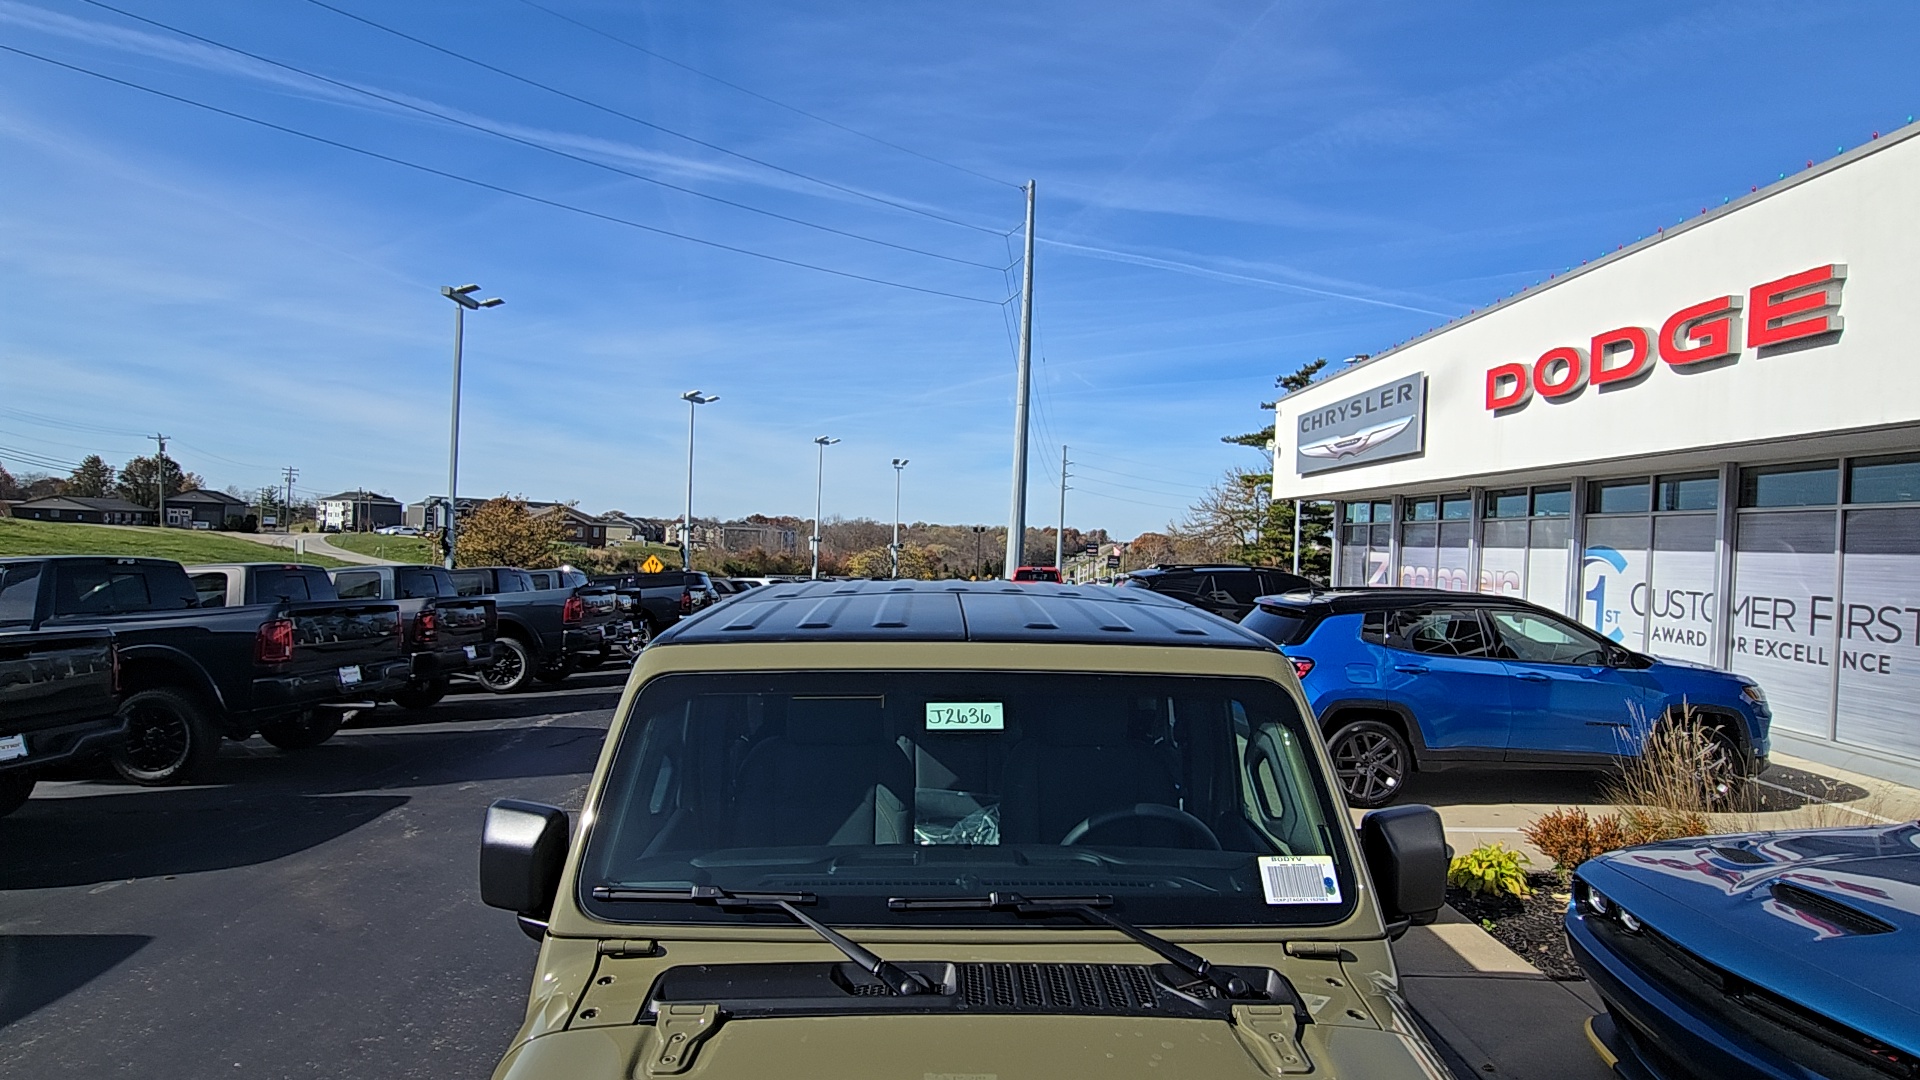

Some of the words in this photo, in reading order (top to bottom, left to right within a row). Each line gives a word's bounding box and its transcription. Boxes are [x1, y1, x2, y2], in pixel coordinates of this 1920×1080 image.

[1486, 264, 1846, 411] DODGE
[1301, 383, 1413, 433] CHRYSLER
[1809, 595, 1920, 647] FIRST
[1651, 626, 1708, 647] AWARD
[1754, 638, 1892, 675] EXCELLNCE
[928, 707, 992, 725] J2636
